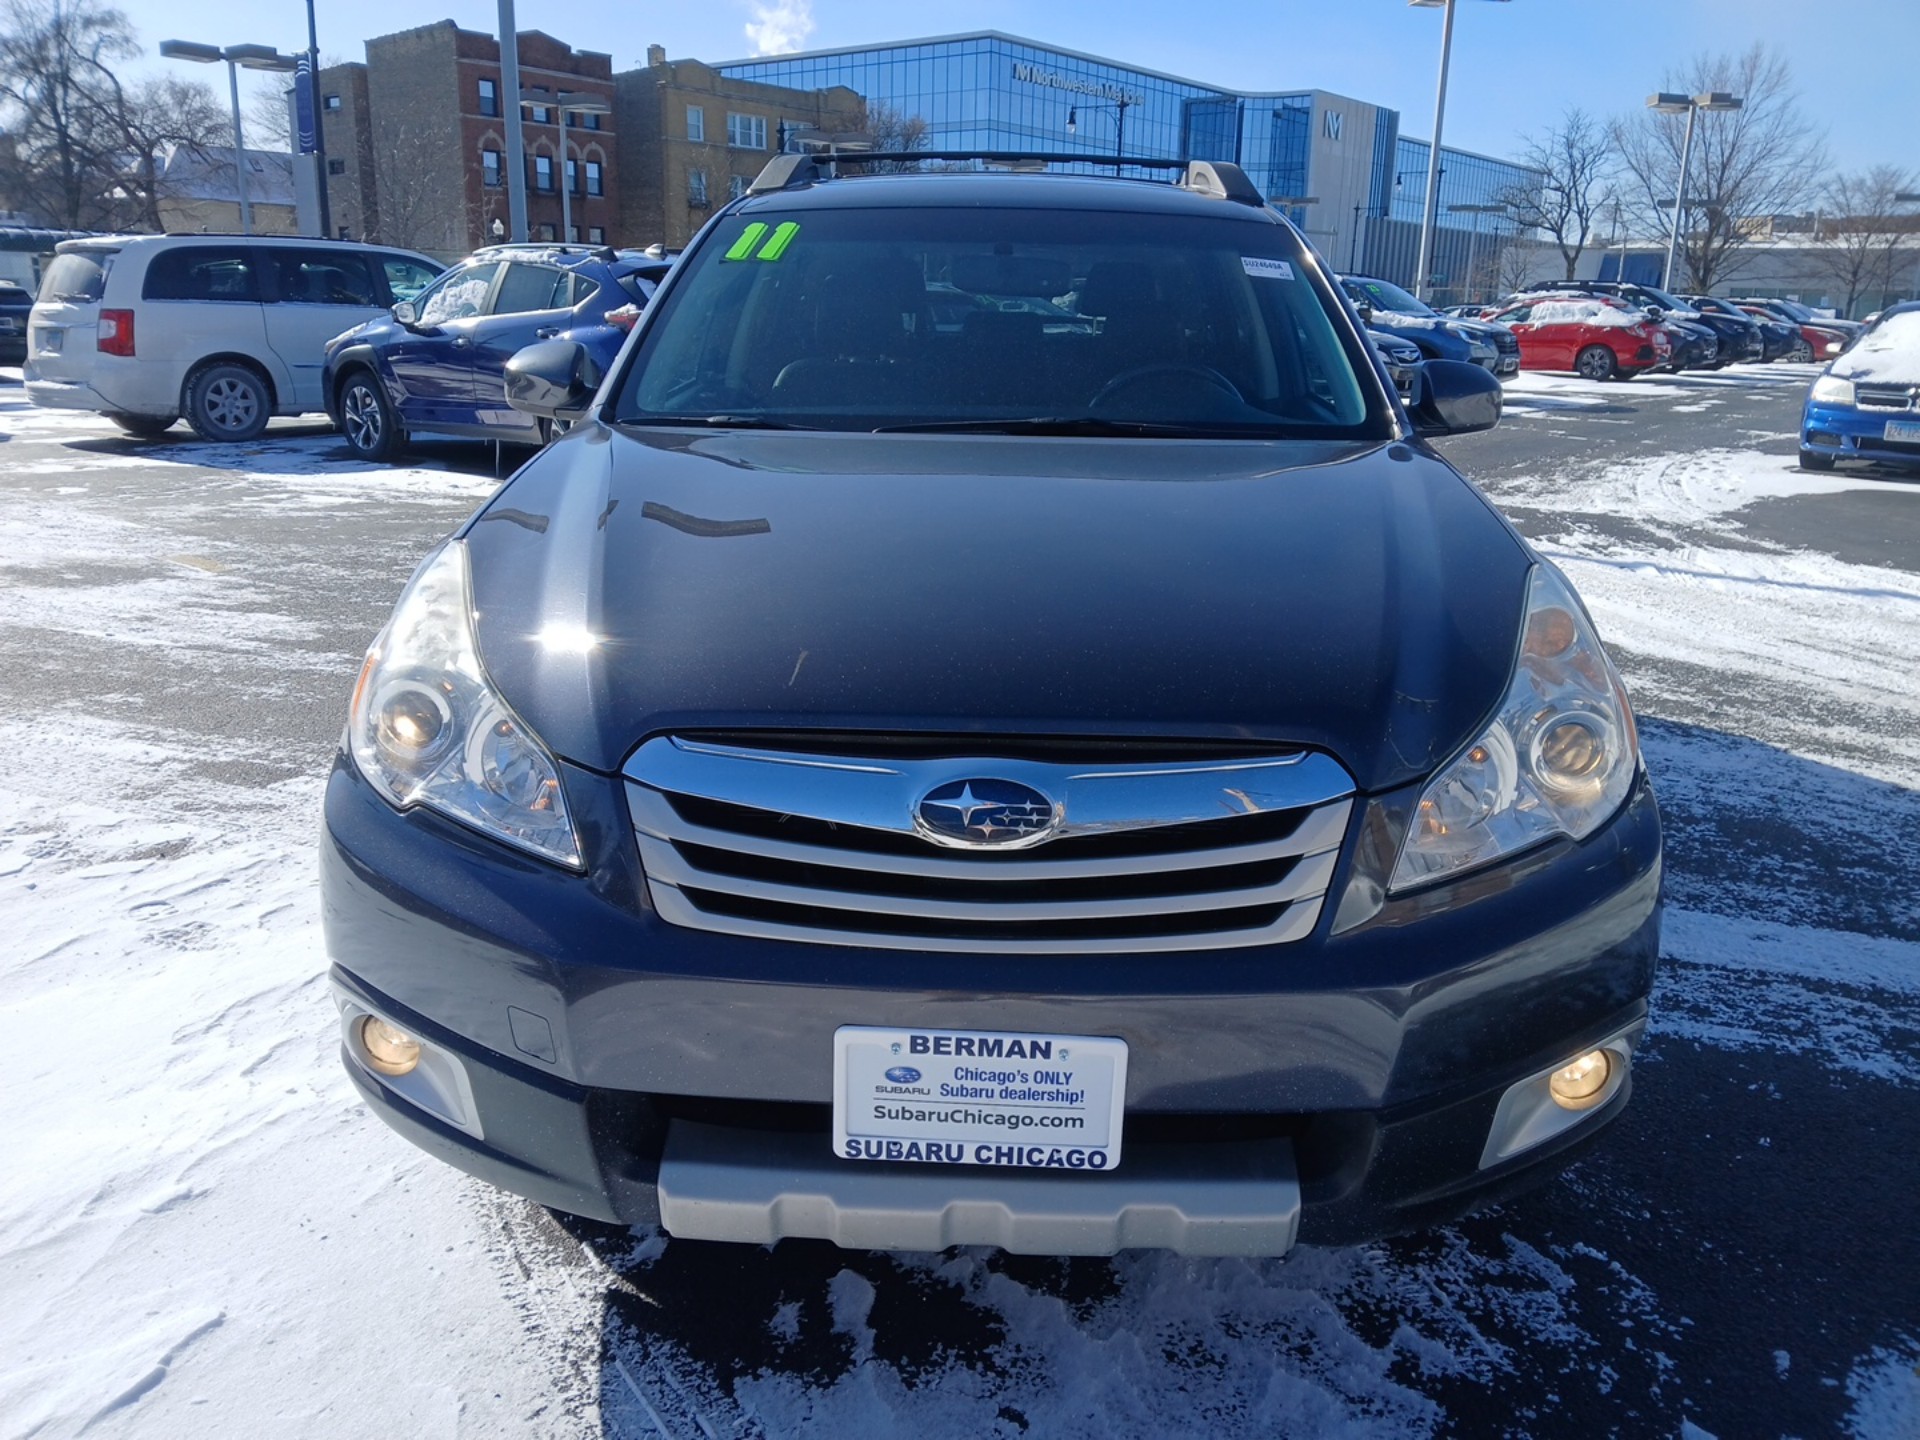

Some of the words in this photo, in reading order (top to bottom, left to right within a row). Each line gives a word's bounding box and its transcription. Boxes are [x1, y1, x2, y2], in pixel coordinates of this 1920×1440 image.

[1031, 65, 1104, 98] Northwestern
[725, 222, 800, 261] 11
[909, 1035, 1053, 1060] BERMAN
[954, 1066, 1029, 1086] Chicago's
[1033, 1071, 1074, 1086] ONLY
[875, 1085, 931, 1096] SUBARU
[940, 1083, 995, 1100] Subaru
[999, 1085, 1085, 1105] dealership!
[873, 1105, 1085, 1130] SubaruChicago.com
[845, 1139, 965, 1163] SUBARU
[974, 1144, 1108, 1169] CHICAGO
